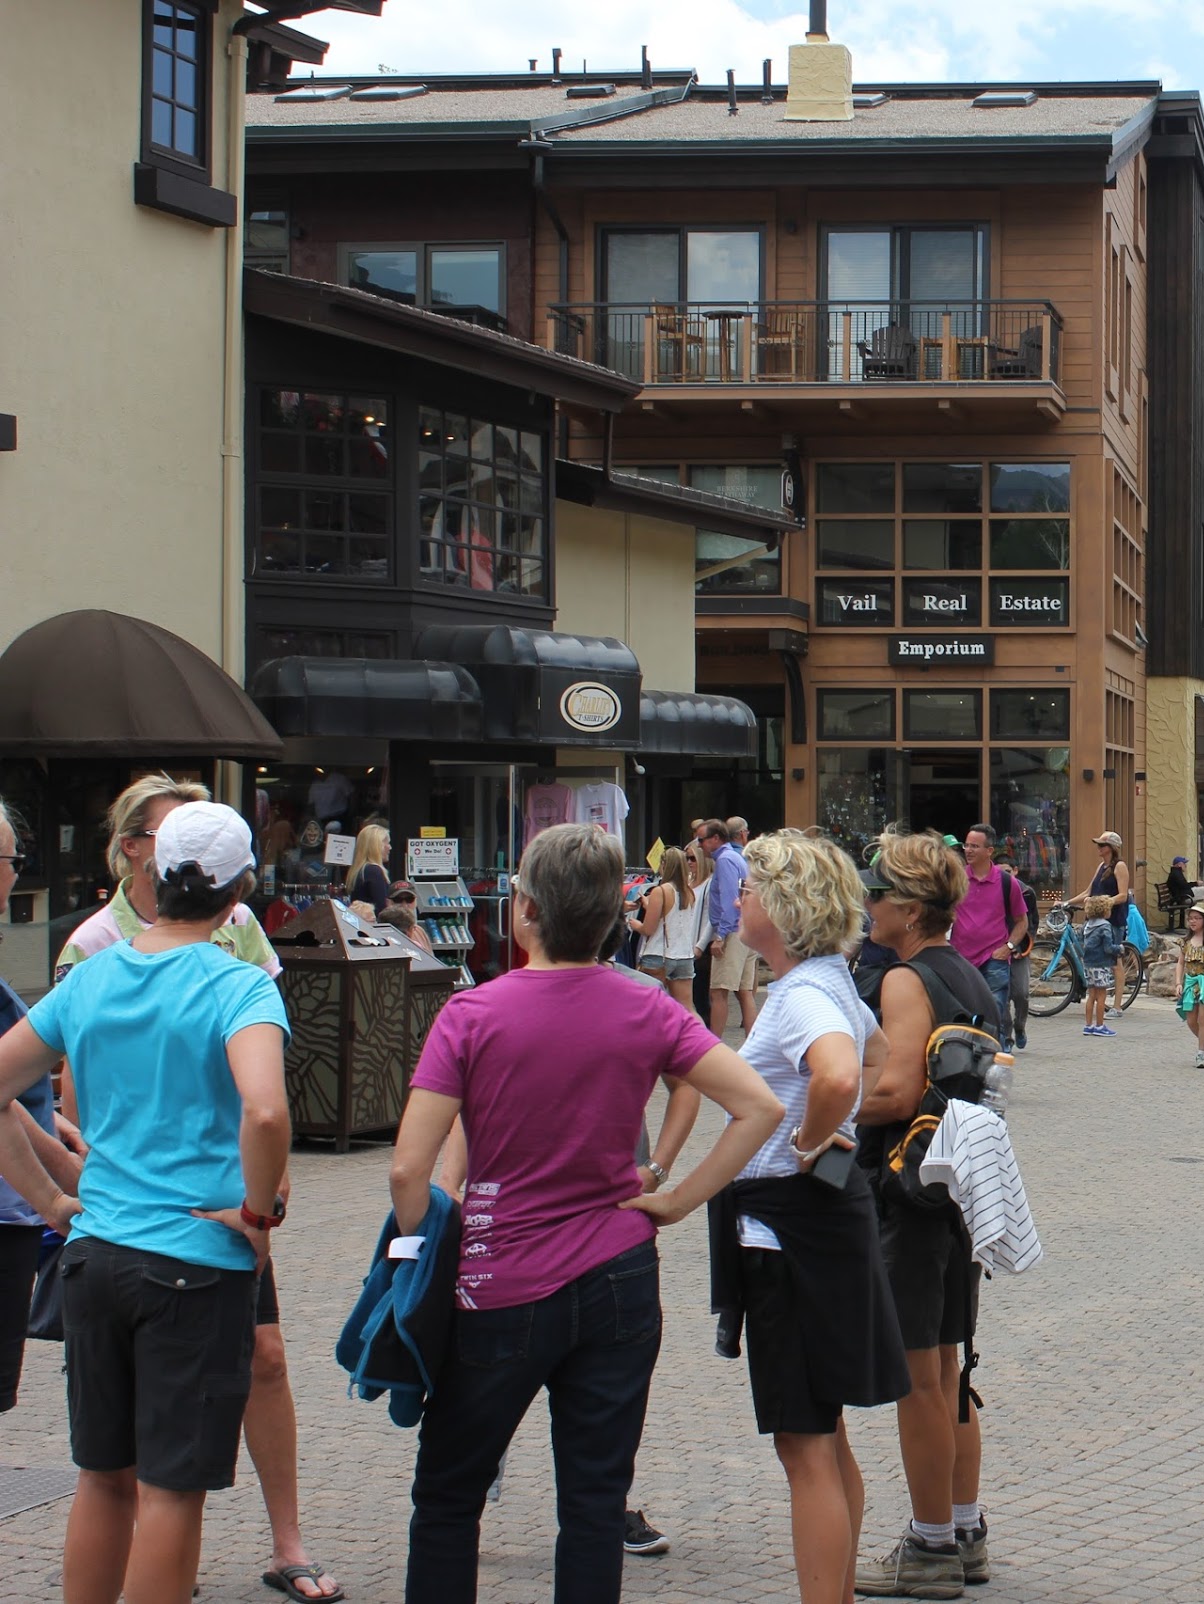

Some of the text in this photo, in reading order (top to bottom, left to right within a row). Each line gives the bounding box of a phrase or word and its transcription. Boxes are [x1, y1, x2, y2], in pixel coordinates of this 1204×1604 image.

[837, 594, 1061, 611] Vail Real Estate
[898, 640, 985, 659] Emporium
